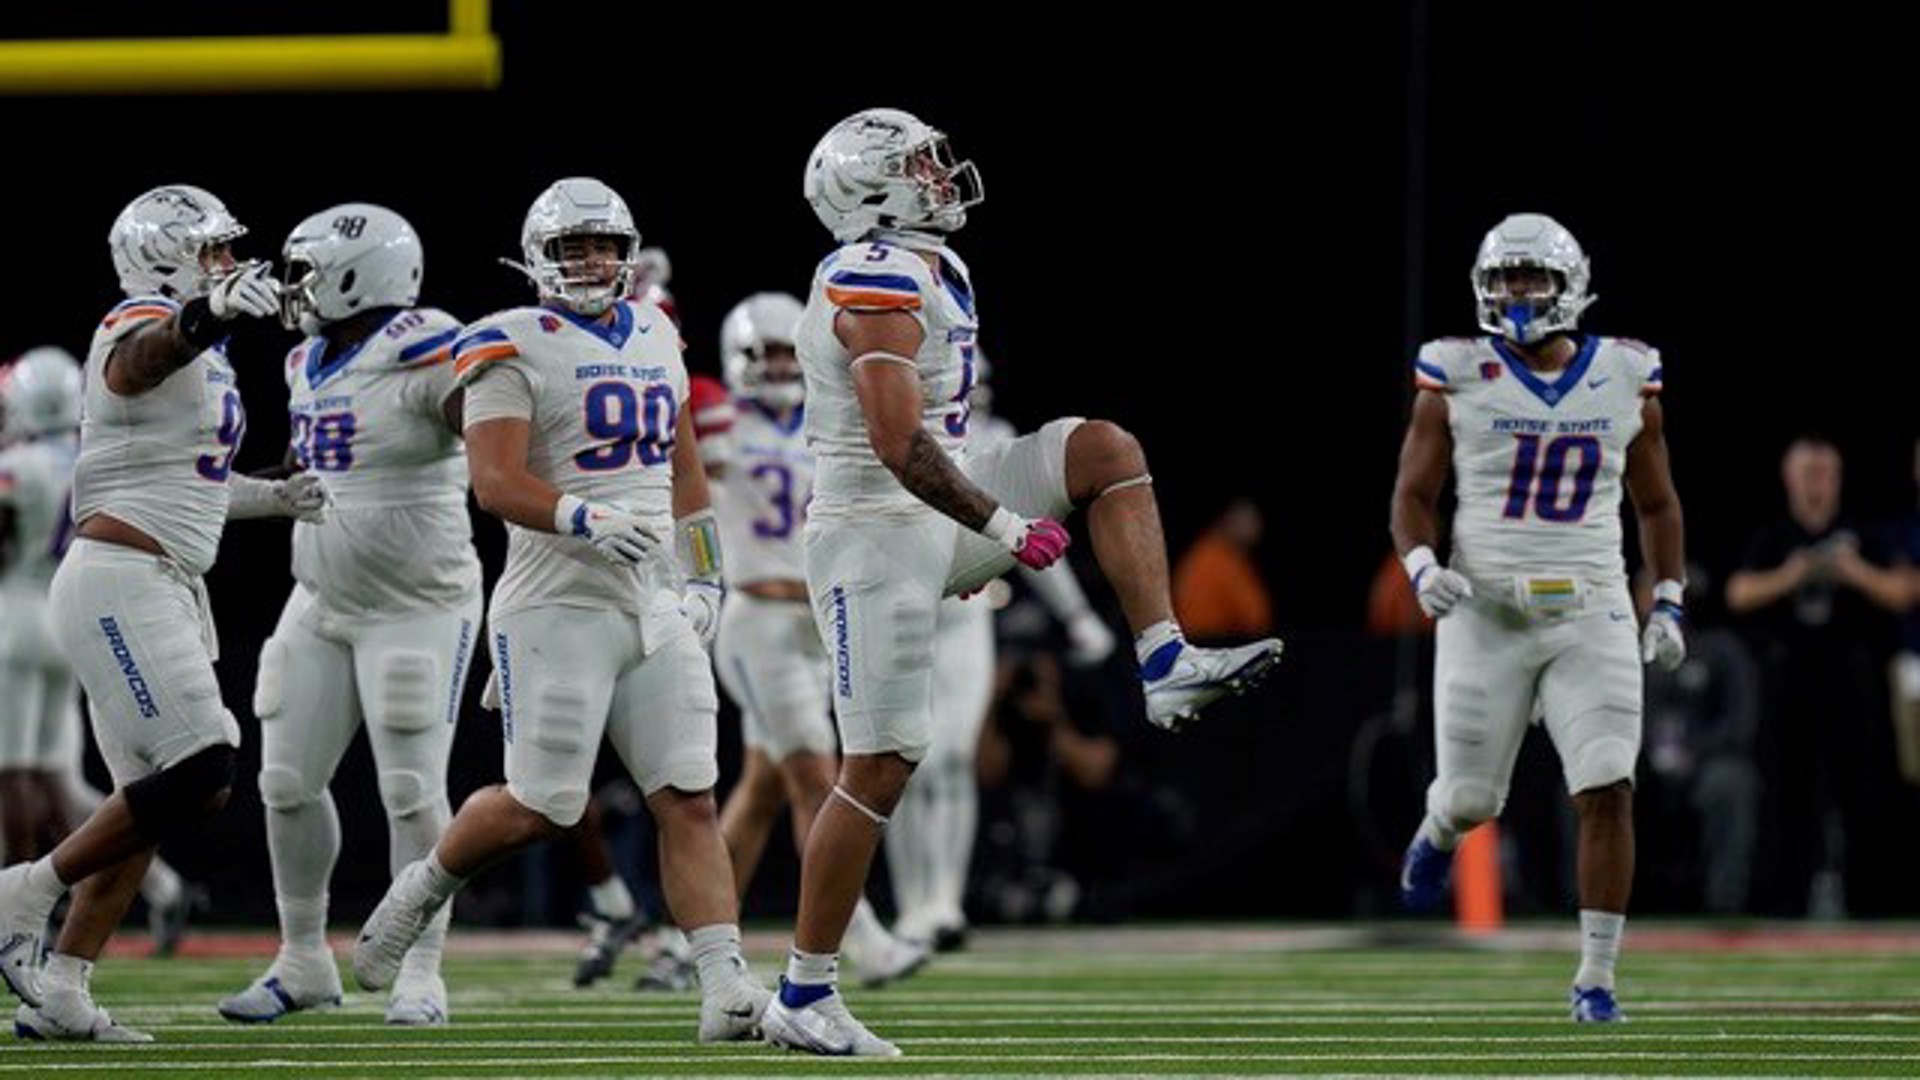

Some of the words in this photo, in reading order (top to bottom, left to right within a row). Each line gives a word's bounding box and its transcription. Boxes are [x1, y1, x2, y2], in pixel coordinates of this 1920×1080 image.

[332, 215, 367, 239] 98
[575, 365, 627, 379] BOISE
[574, 379, 678, 472] 90
[1492, 418, 1551, 432] BOISE
[1557, 418, 1612, 432] STATE
[1502, 432, 1602, 523] 10
[98, 615, 160, 719] BRONCOS
[832, 586, 852, 699] BRONCOS
